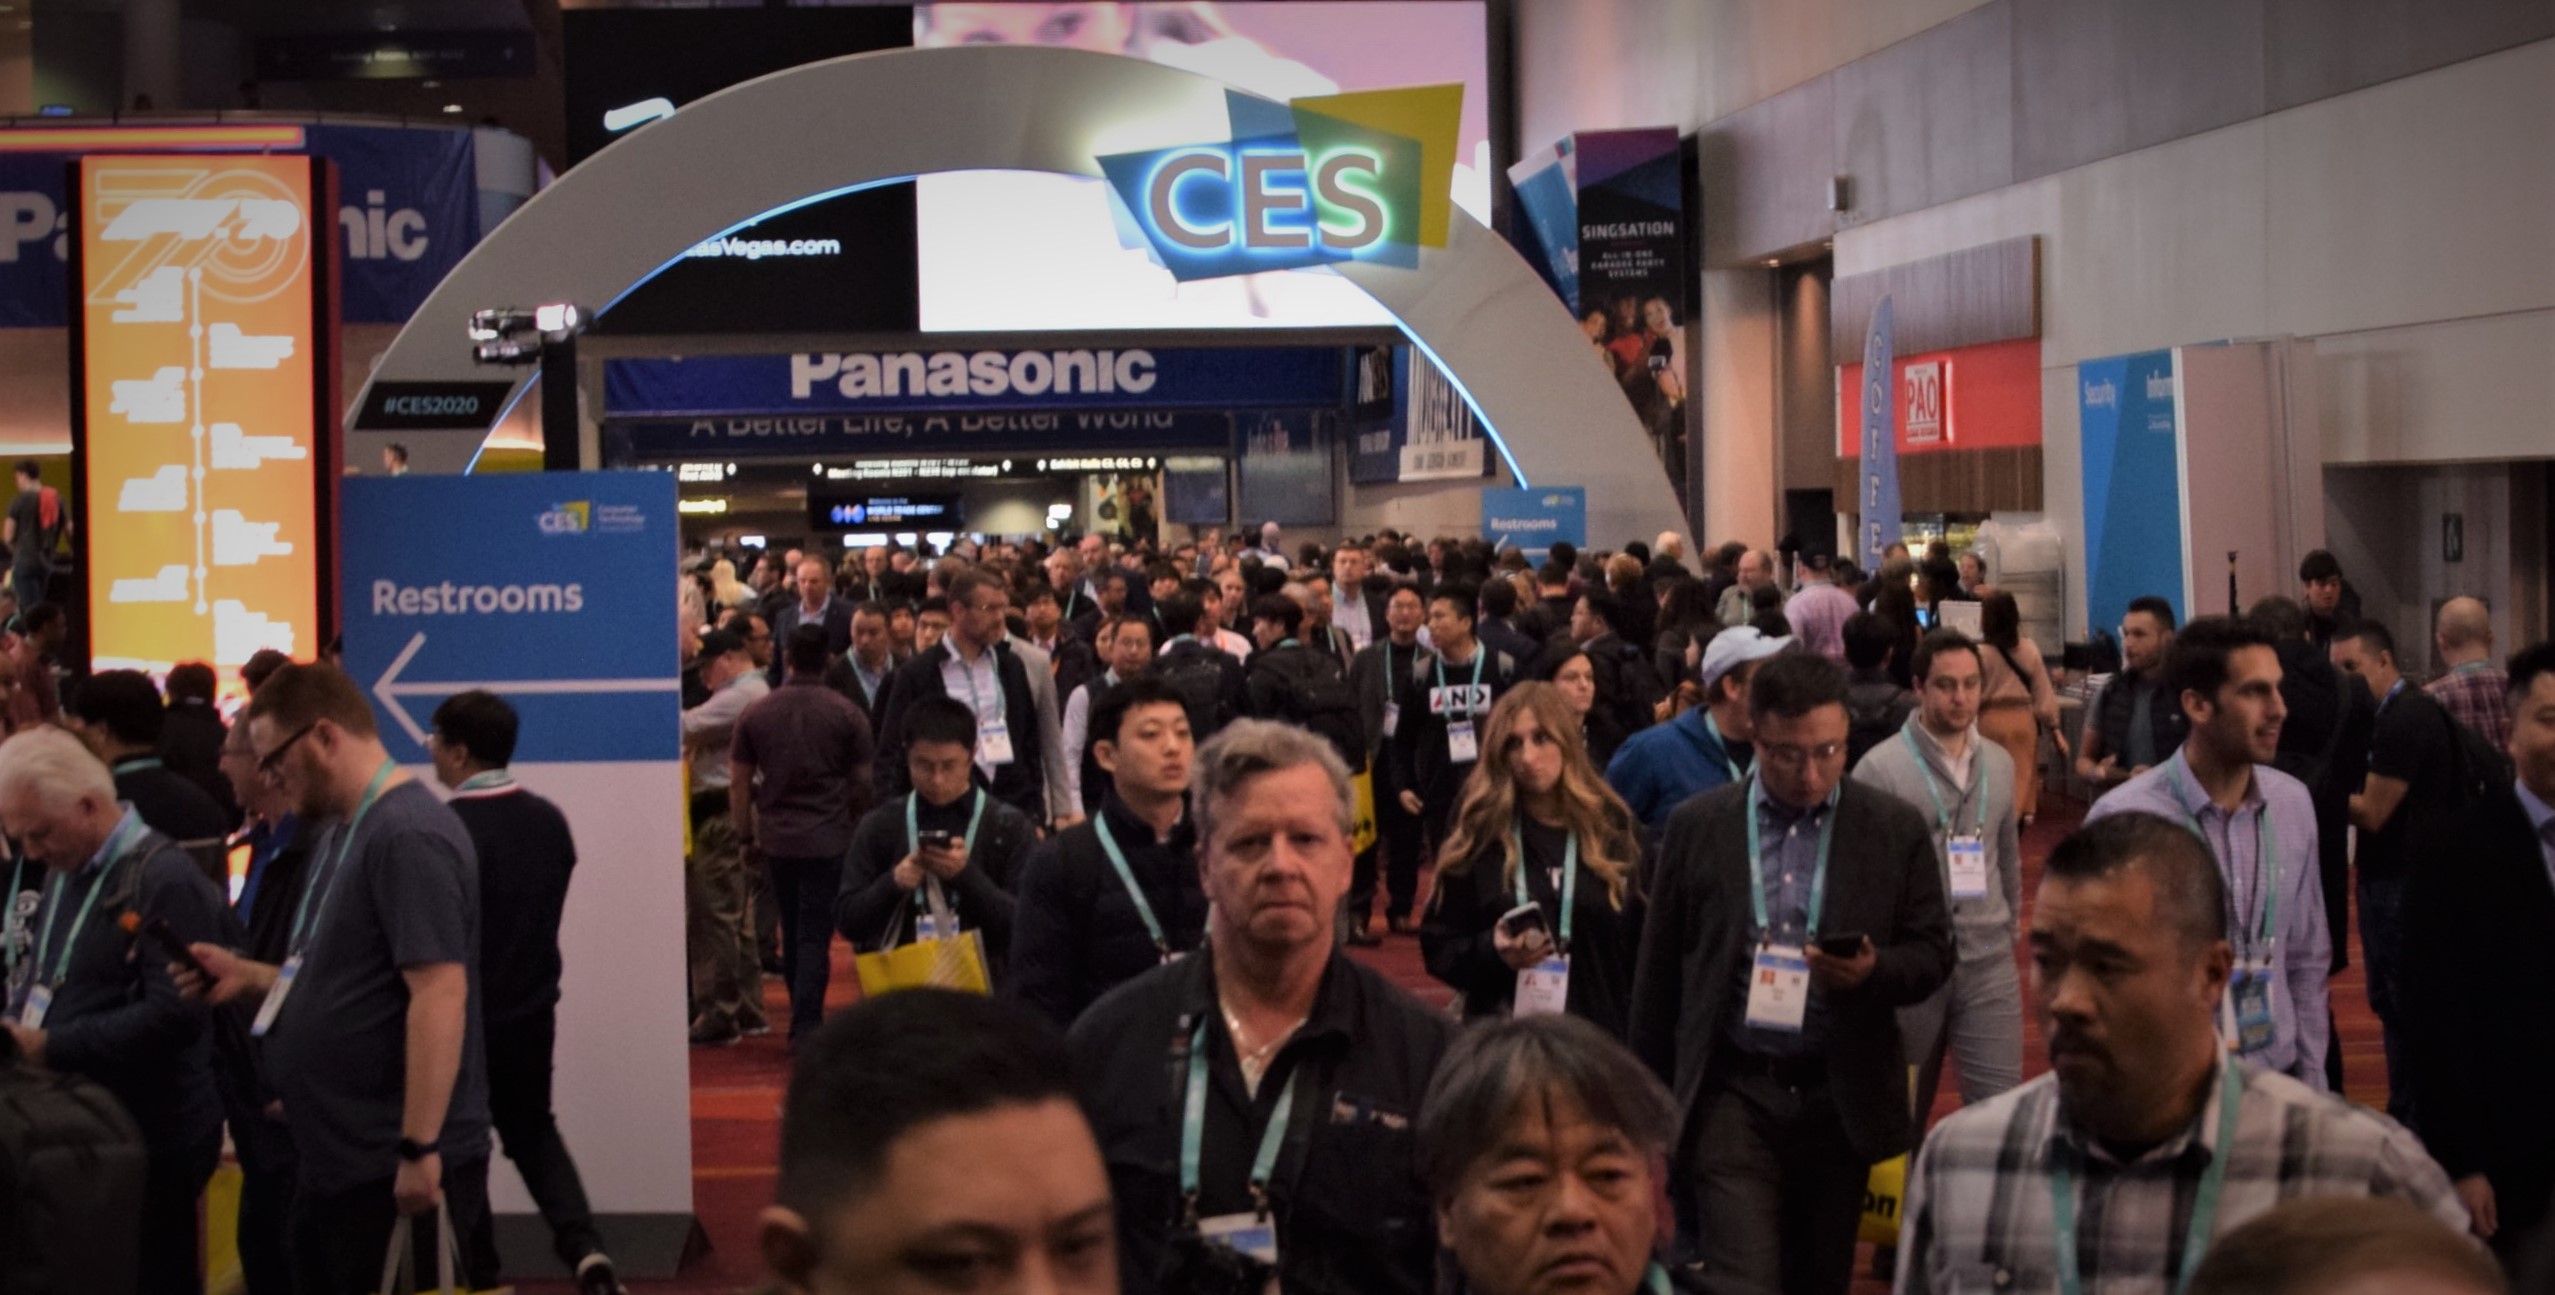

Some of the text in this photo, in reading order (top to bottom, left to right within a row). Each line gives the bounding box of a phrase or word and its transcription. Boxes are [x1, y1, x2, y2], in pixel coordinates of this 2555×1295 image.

[1147, 148, 1387, 251] CES
[1582, 221, 1674, 240] SINGSATION
[790, 348, 1157, 398] Panasonic
[383, 395, 479, 415] #CES2020
[1907, 375, 1938, 420] PAO
[1868, 331, 1884, 578] COFFE
[539, 510, 579, 533] CES
[1491, 517, 1557, 531] Restrooms
[373, 579, 584, 616] Restrooms
